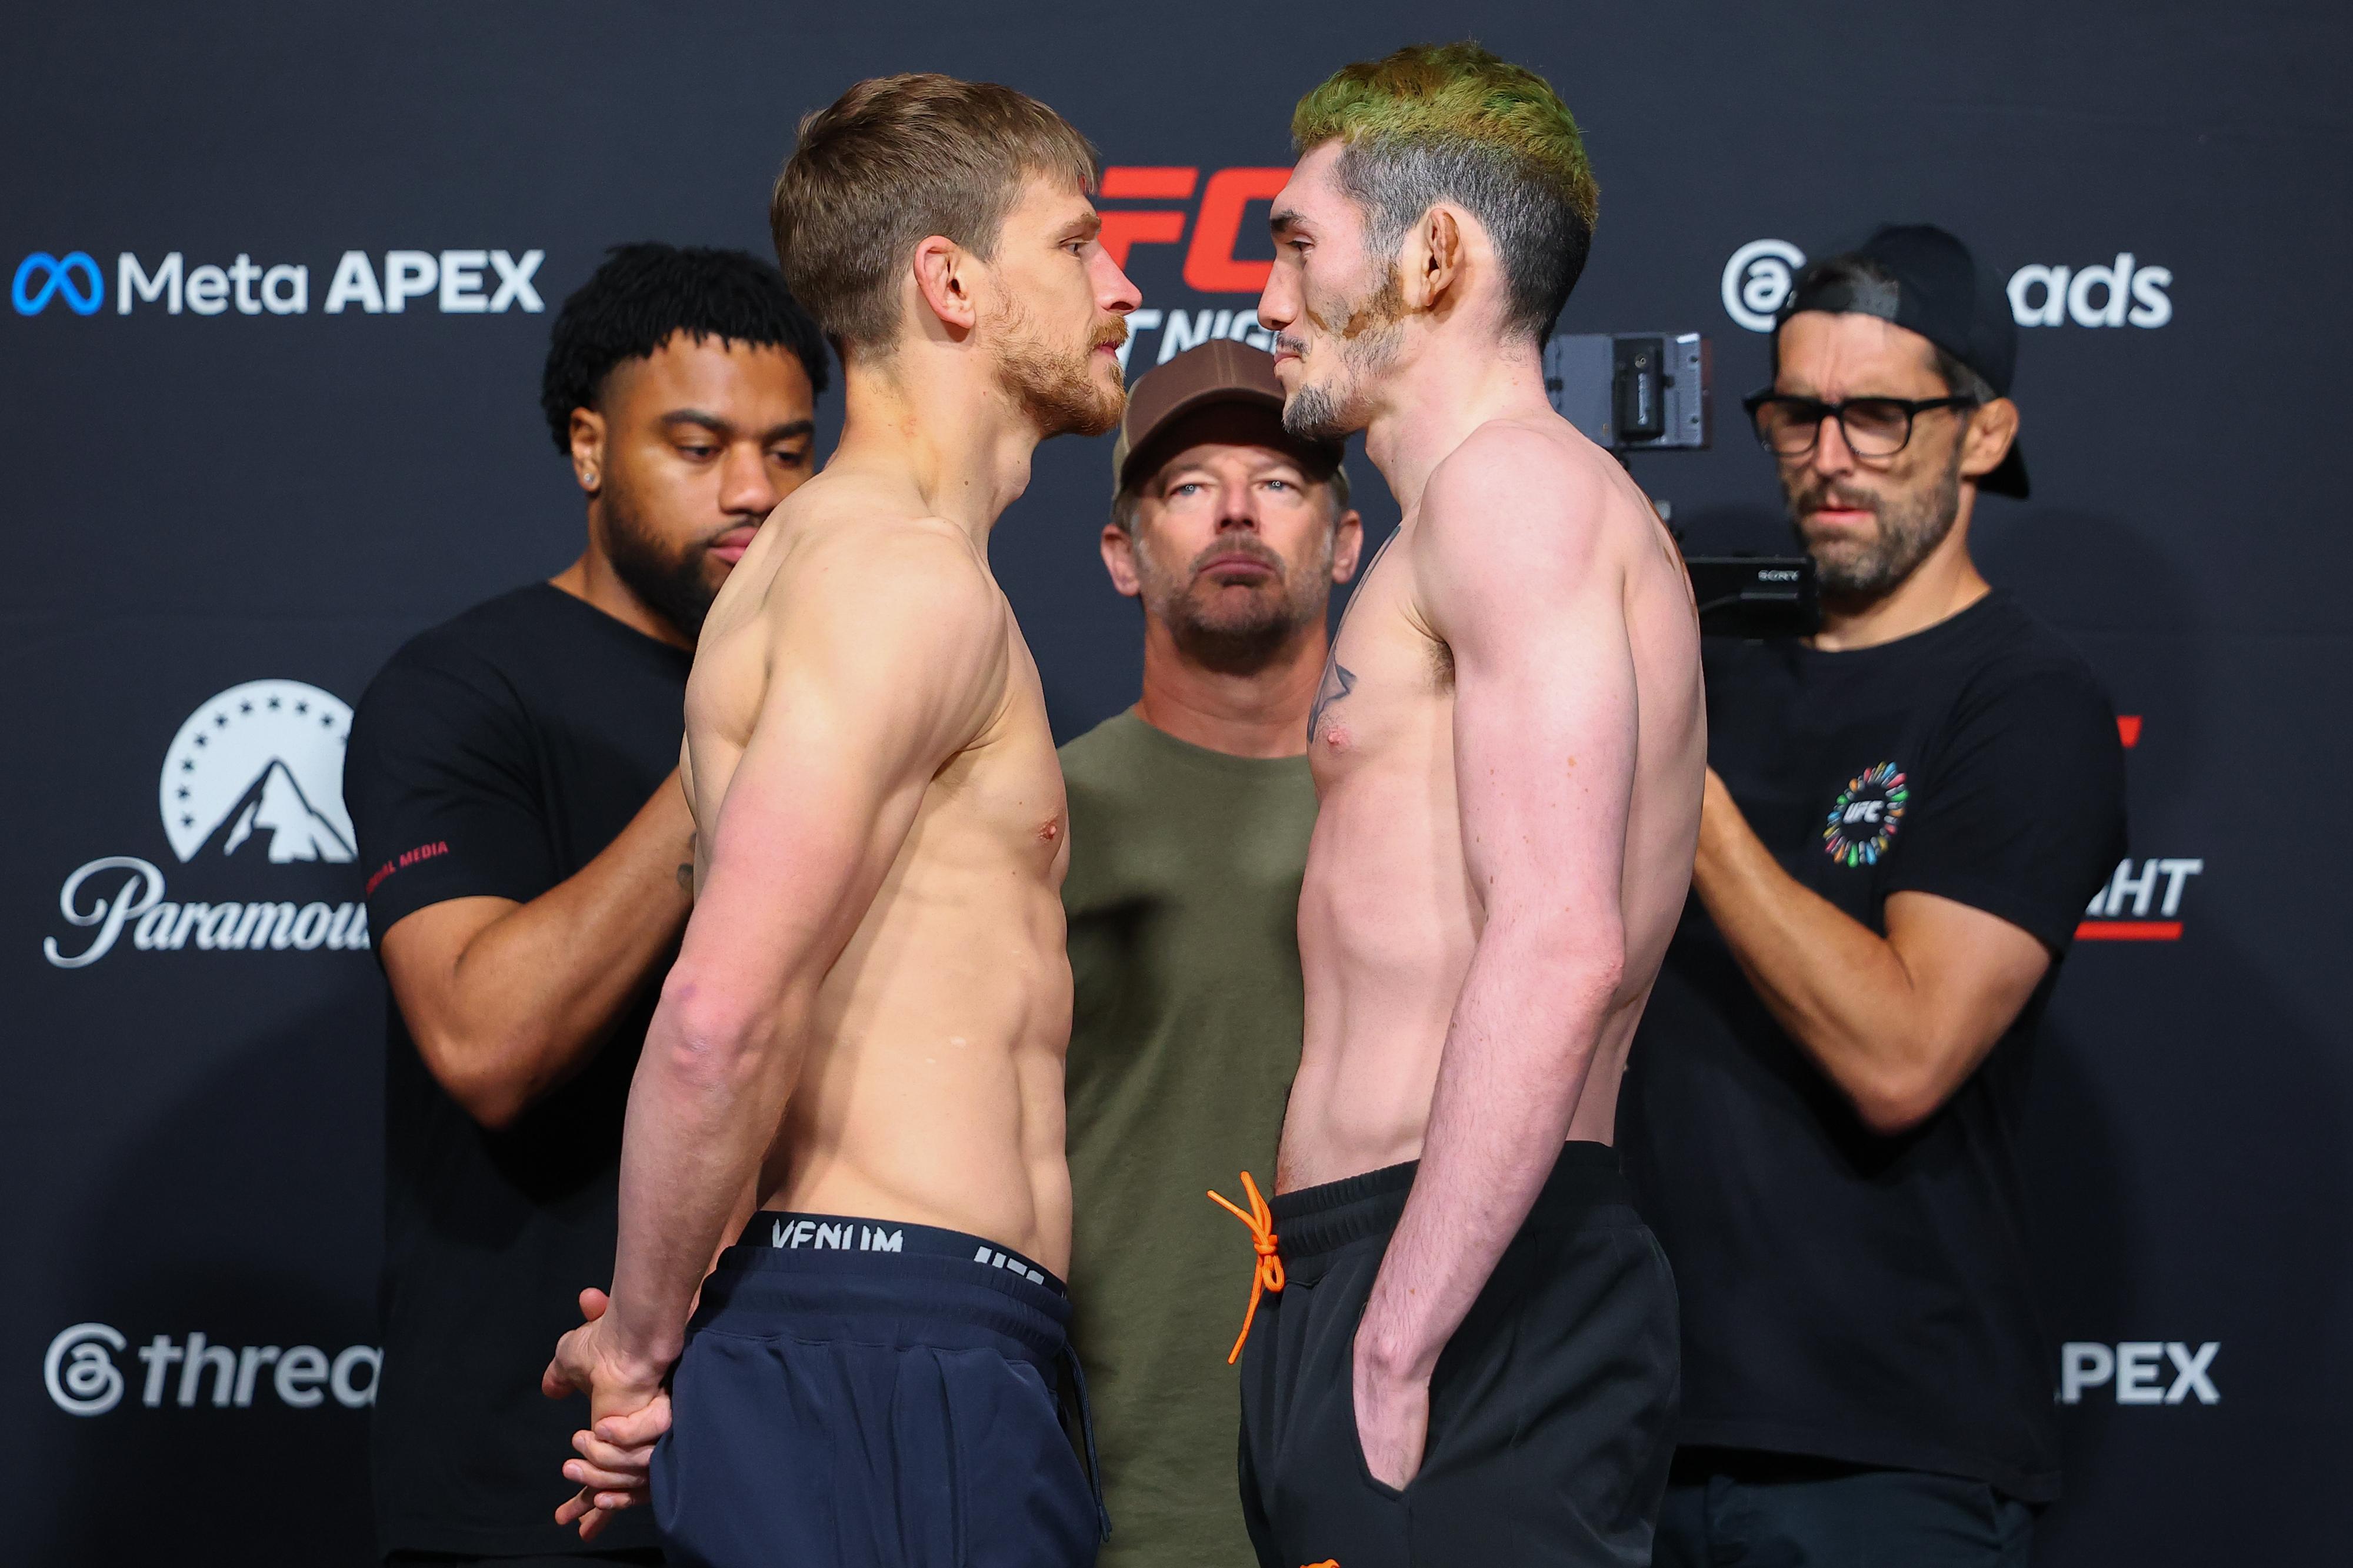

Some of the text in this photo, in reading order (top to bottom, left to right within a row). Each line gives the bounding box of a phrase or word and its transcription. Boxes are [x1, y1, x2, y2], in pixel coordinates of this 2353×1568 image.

[1095, 166, 1294, 293] FC
[117, 249, 545, 315] Meta APEX
[1156, 309, 1277, 366] NIG
[1758, 569, 1798, 582] SONY
[1842, 800, 1884, 823] UFC
[399, 840, 449, 868] MEDIA
[44, 856, 371, 968] Paramou
[2085, 859, 2204, 916] HT
[2055, 1342, 2221, 1404] PEX
